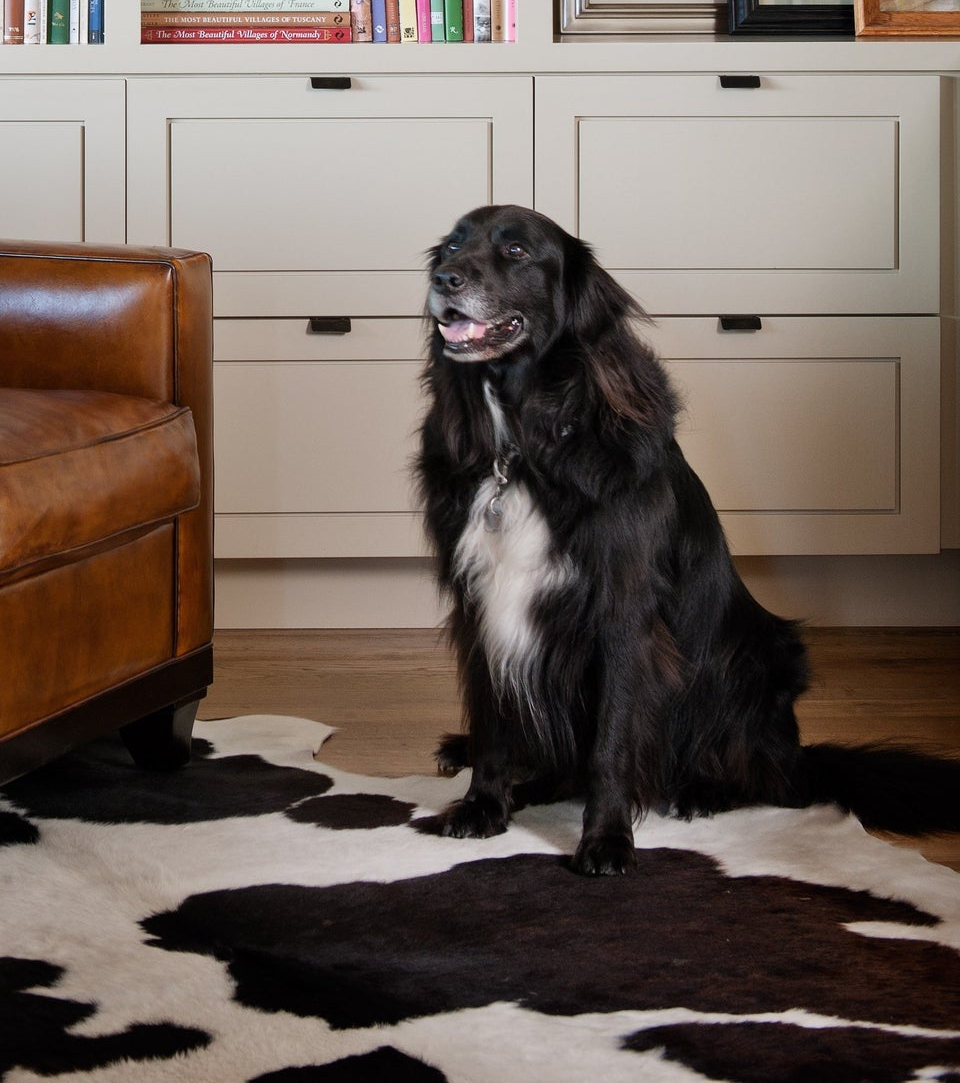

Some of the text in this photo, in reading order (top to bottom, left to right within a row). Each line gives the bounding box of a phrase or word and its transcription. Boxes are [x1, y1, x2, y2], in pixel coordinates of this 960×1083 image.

[156, 29, 321, 41] The Most Beautiful Villages of Normandy
